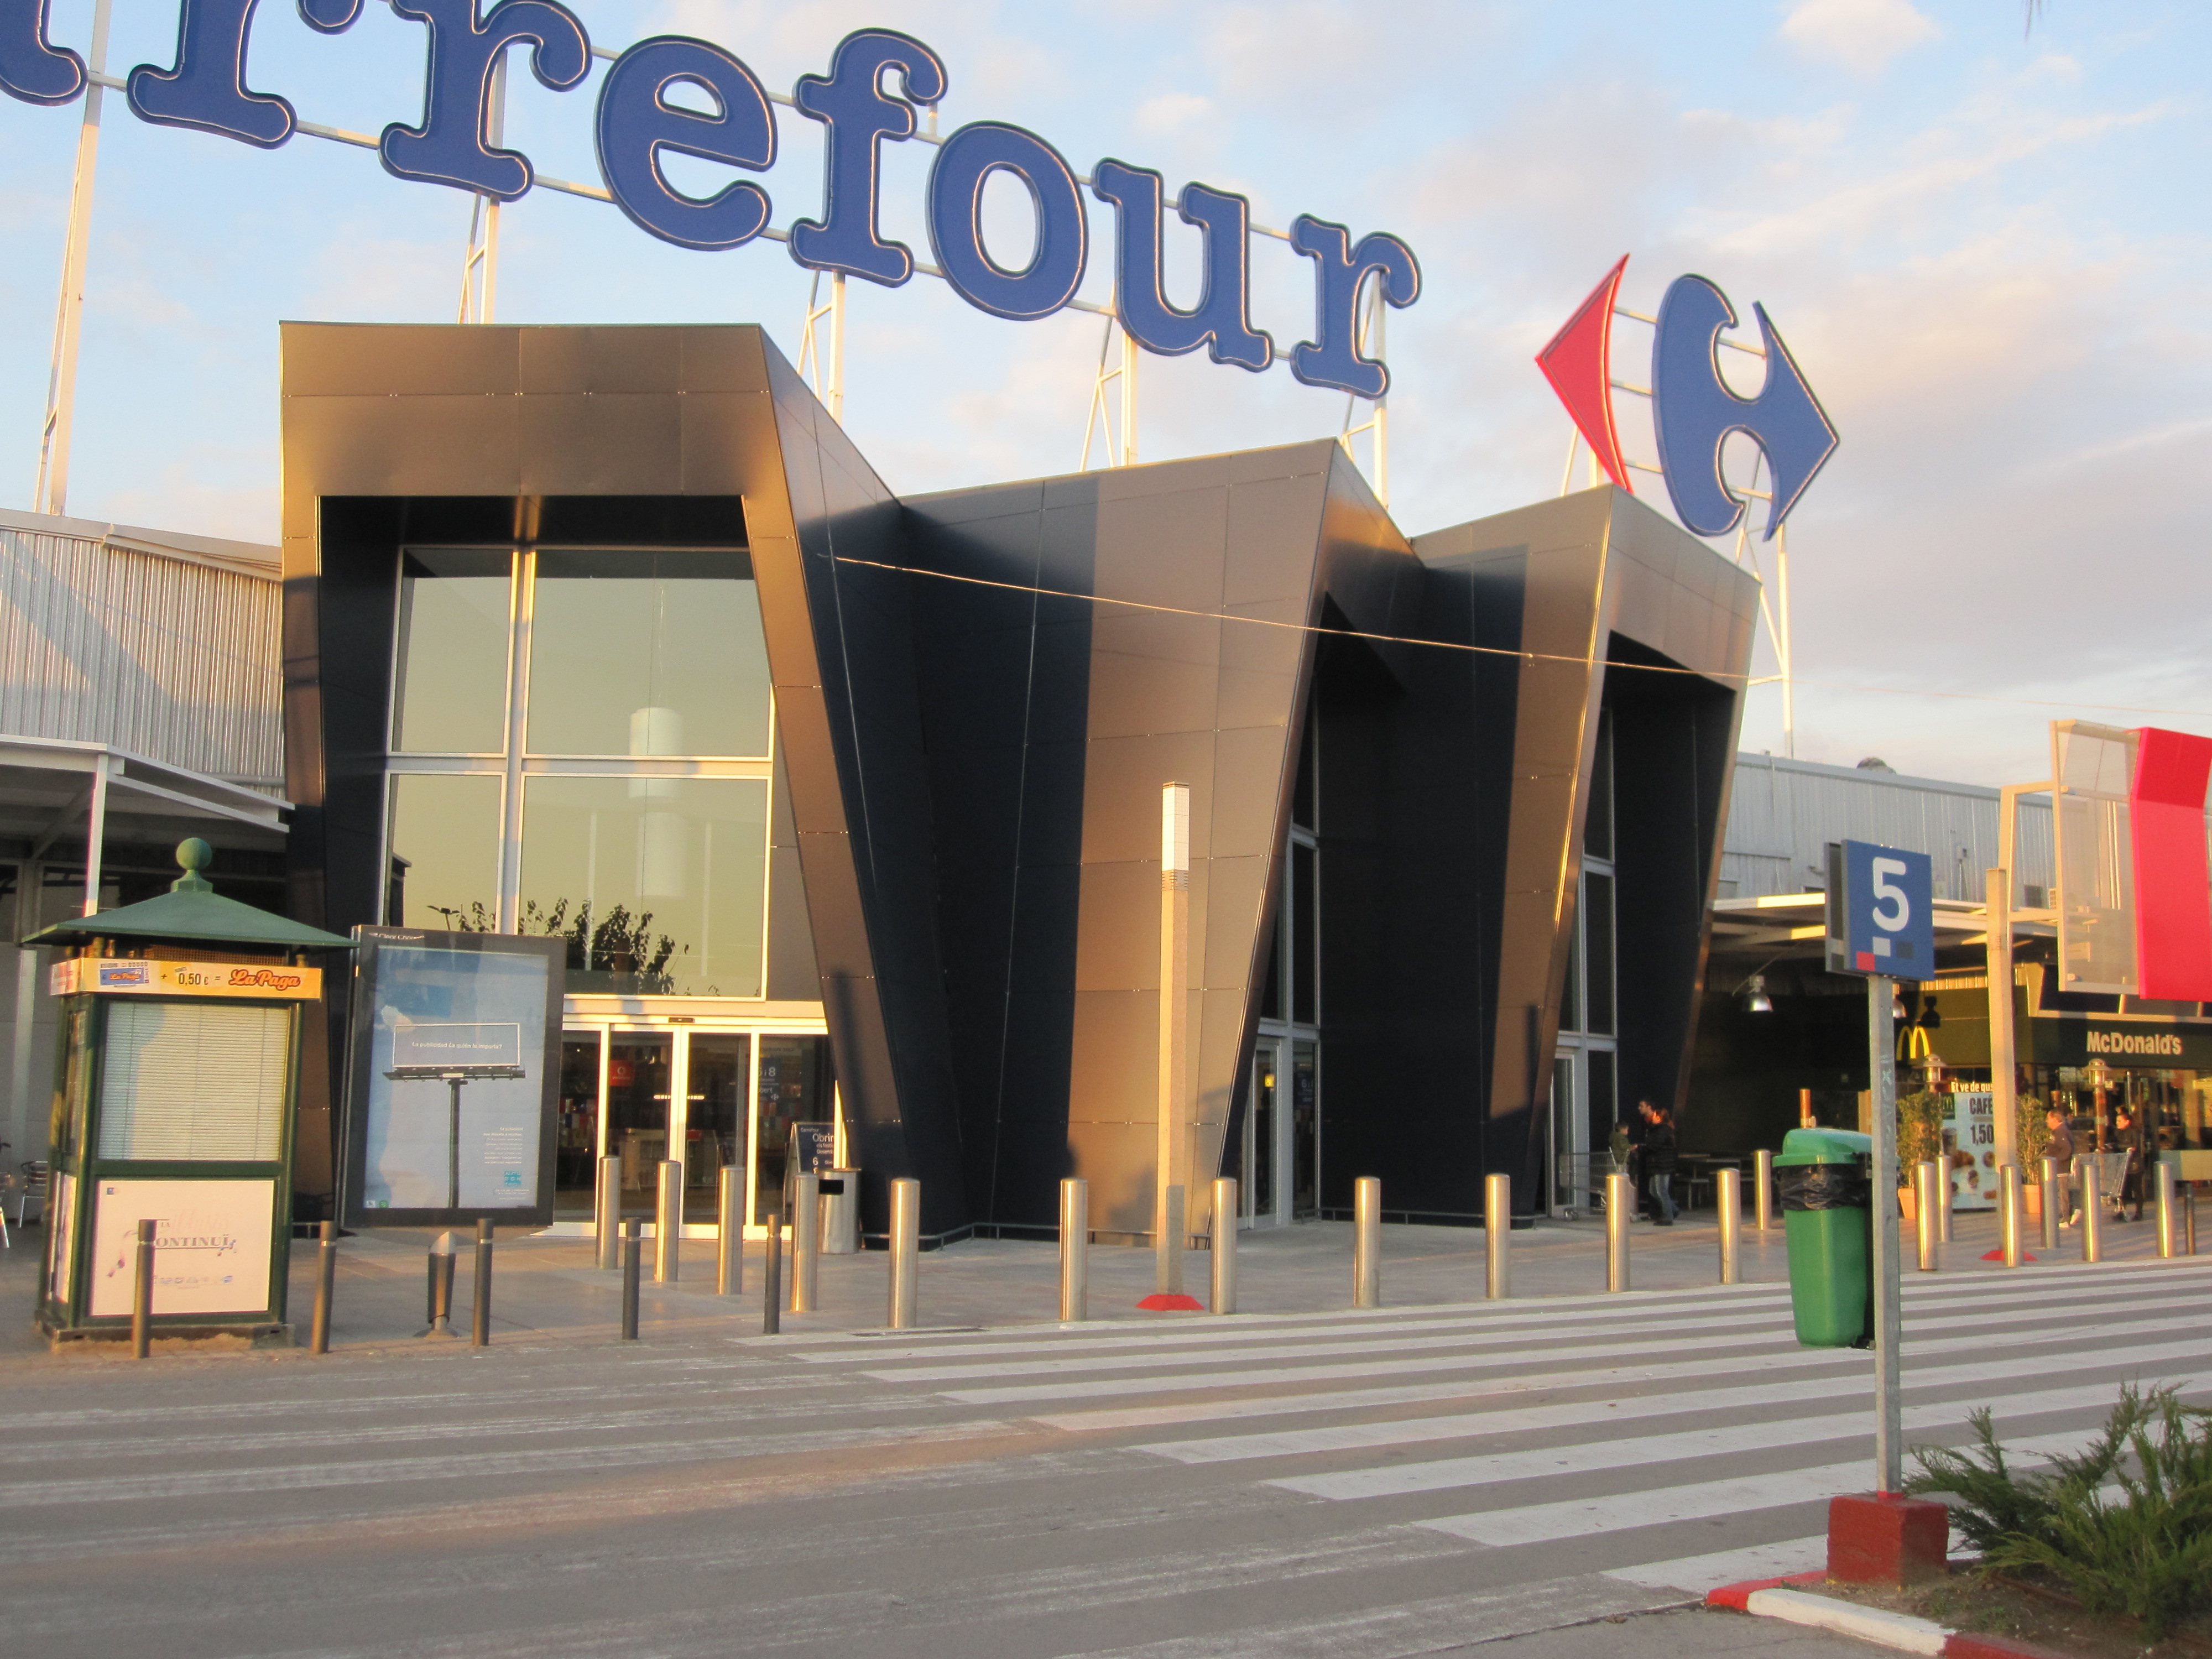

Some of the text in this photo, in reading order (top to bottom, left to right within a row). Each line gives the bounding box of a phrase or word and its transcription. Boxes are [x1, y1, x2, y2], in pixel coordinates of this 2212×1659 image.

[1872, 857, 1910, 932] 5
[178, 973, 201, 987] 0,50
[228, 969, 257, 987] La
[255, 969, 301, 992] Paga
[2086, 1031, 2183, 1056] McDonald's
[768, 1067, 775, 1077] 8
[1951, 1082, 1959, 1093] Et
[1960, 1083, 1969, 1093] ve
[1970, 1081, 1980, 1093] de
[1969, 1094, 1993, 1115] CAFÉ
[1970, 1124, 1994, 1146] 1,50
[812, 1157, 818, 1166] 6
[155, 1234, 229, 1247] ONTINUÏ
